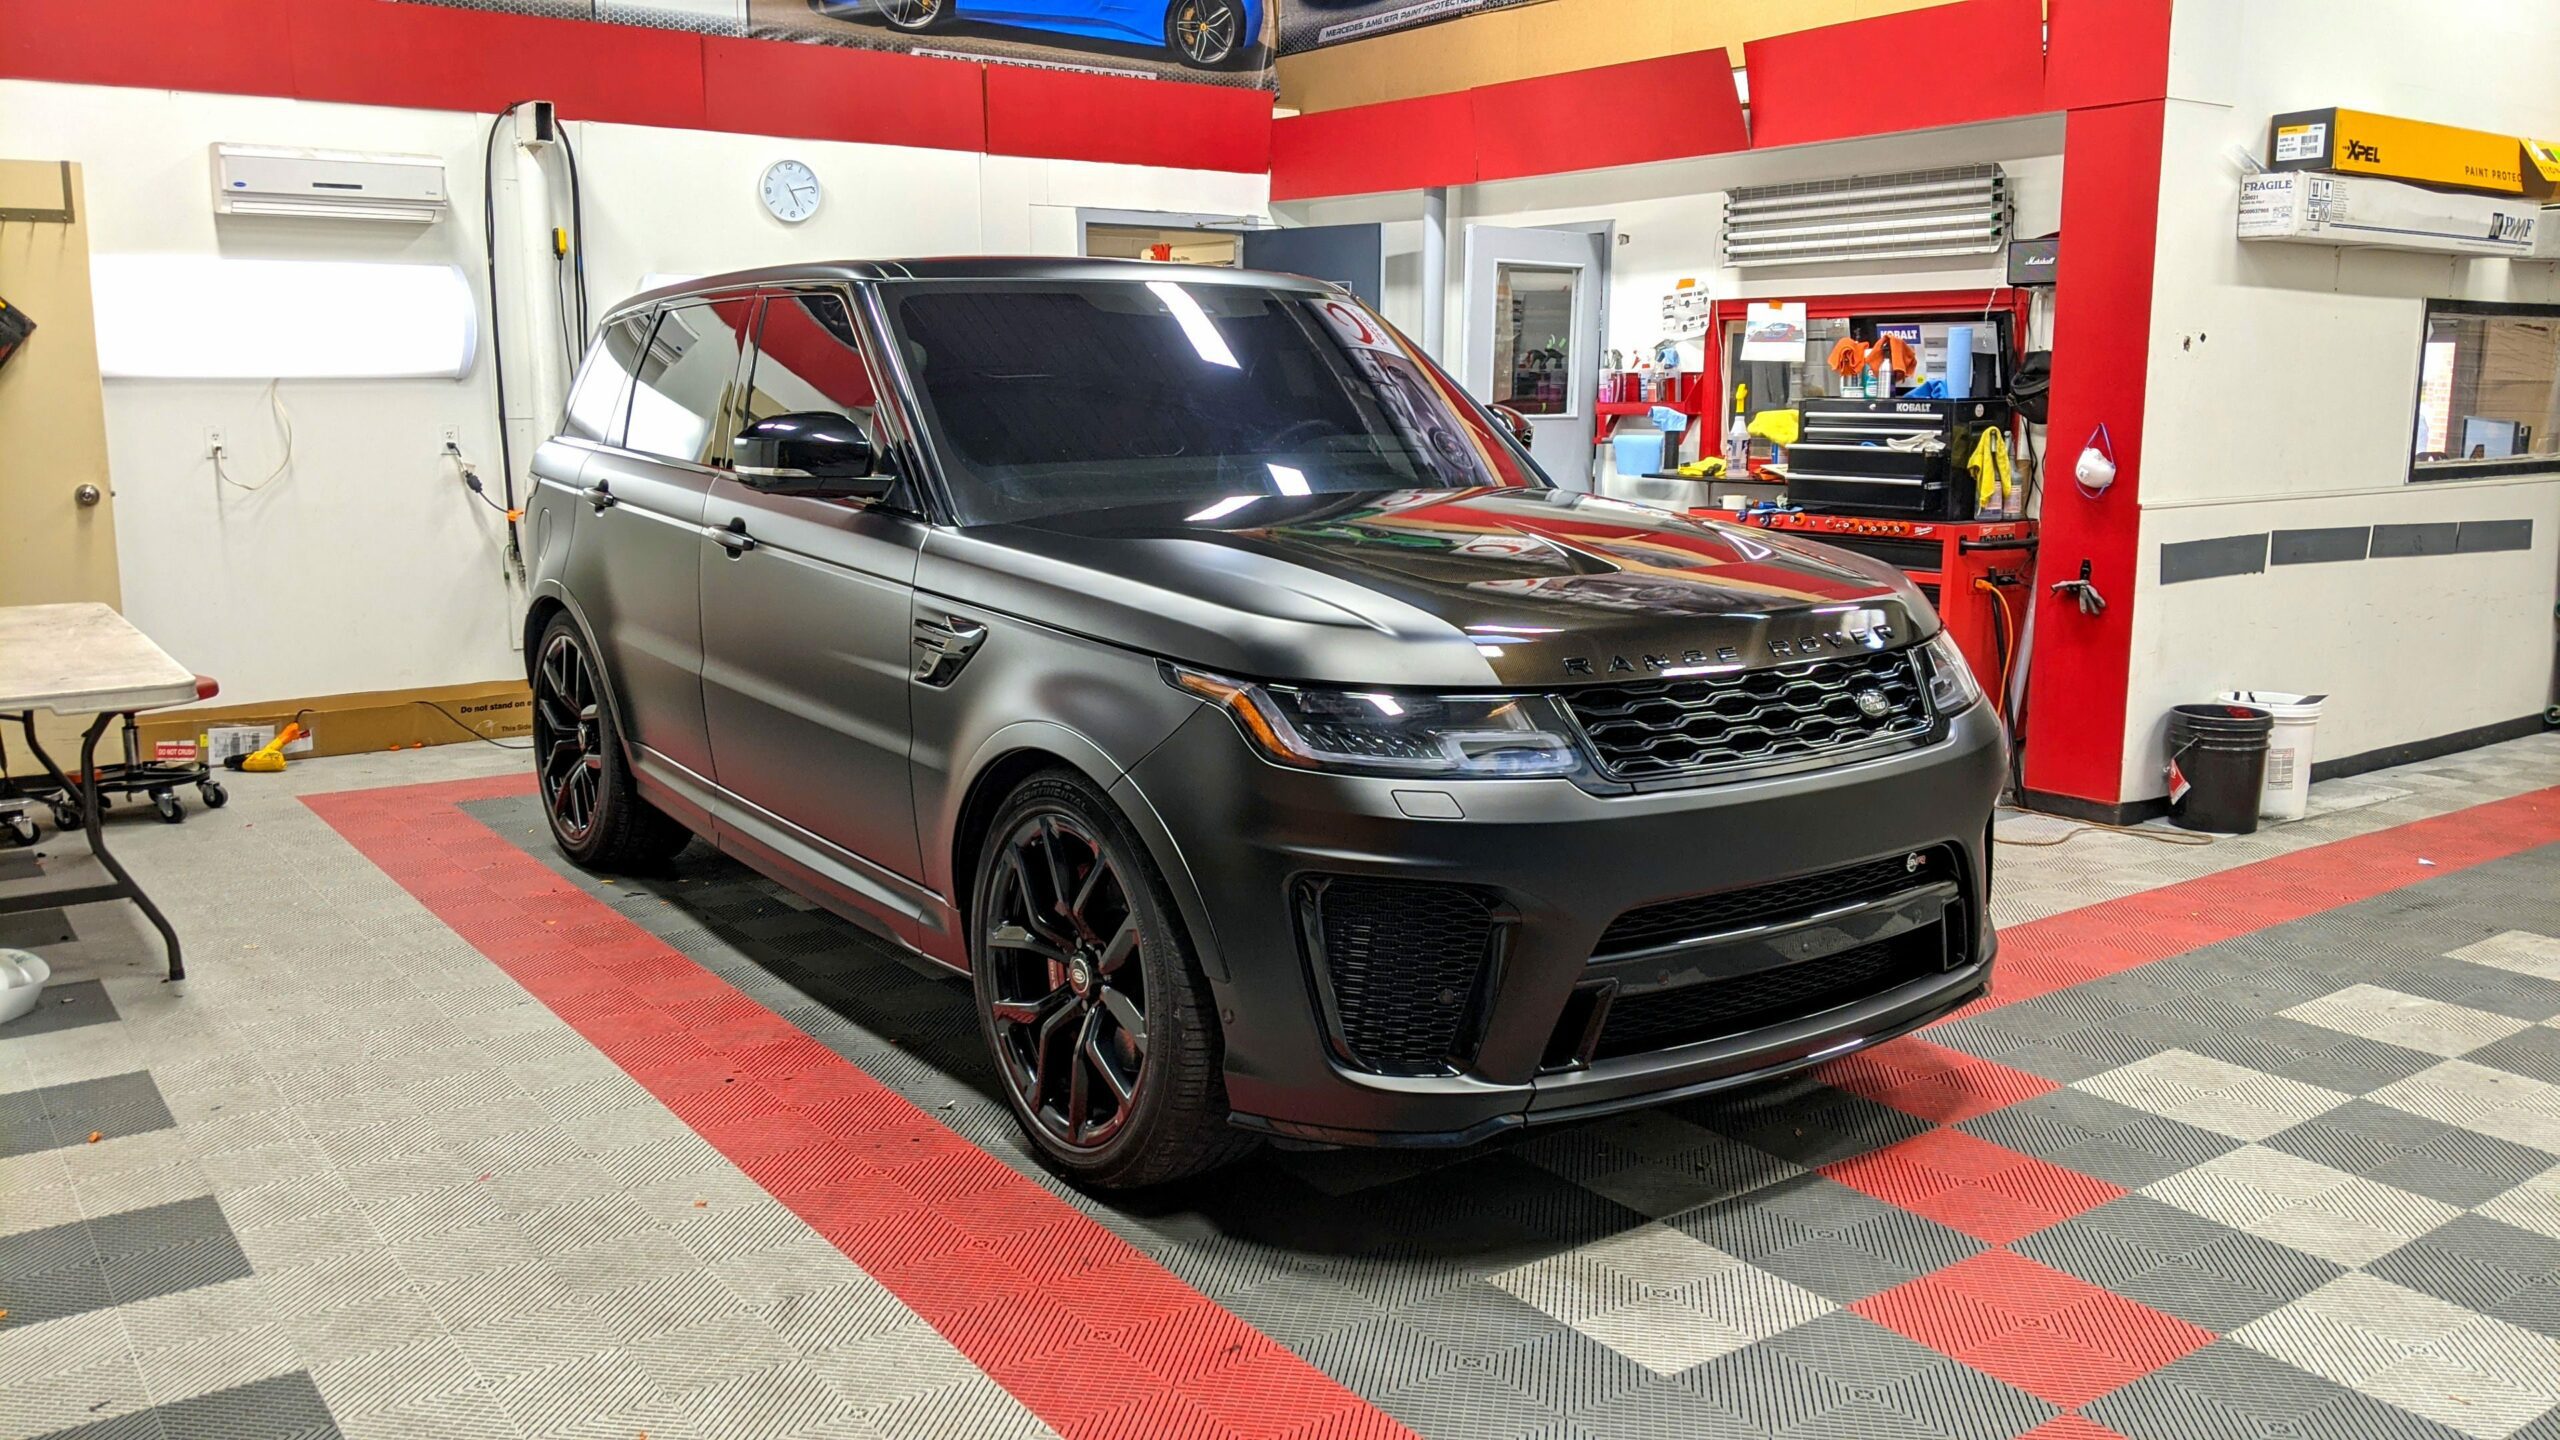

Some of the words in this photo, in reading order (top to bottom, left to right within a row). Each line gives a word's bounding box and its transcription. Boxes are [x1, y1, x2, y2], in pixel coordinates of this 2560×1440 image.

[1326, 23, 1364, 37] MERCEDES
[1365, 19, 1383, 28] AMG
[1384, 14, 1399, 23] GTR
[1401, 8, 1423, 19] PAINT
[2346, 139, 2381, 163] XPEL
[2465, 165, 2489, 179] PAINT
[2244, 180, 2293, 192] FRAGILE
[790, 210, 796, 218] 6
[1151, 243, 1172, 262] 3M
[1896, 403, 1932, 412] KOBALT
[1563, 646, 1739, 676] RANGE
[1768, 624, 1895, 658] ROVER
[461, 706, 473, 714] Do
[474, 704, 488, 712] not
[489, 701, 513, 711] stand
[515, 700, 525, 708] on
[501, 724, 516, 732] This
[518, 723, 532, 731] Side
[167, 748, 178, 756] NOT
[178, 748, 195, 756] CRUSH
